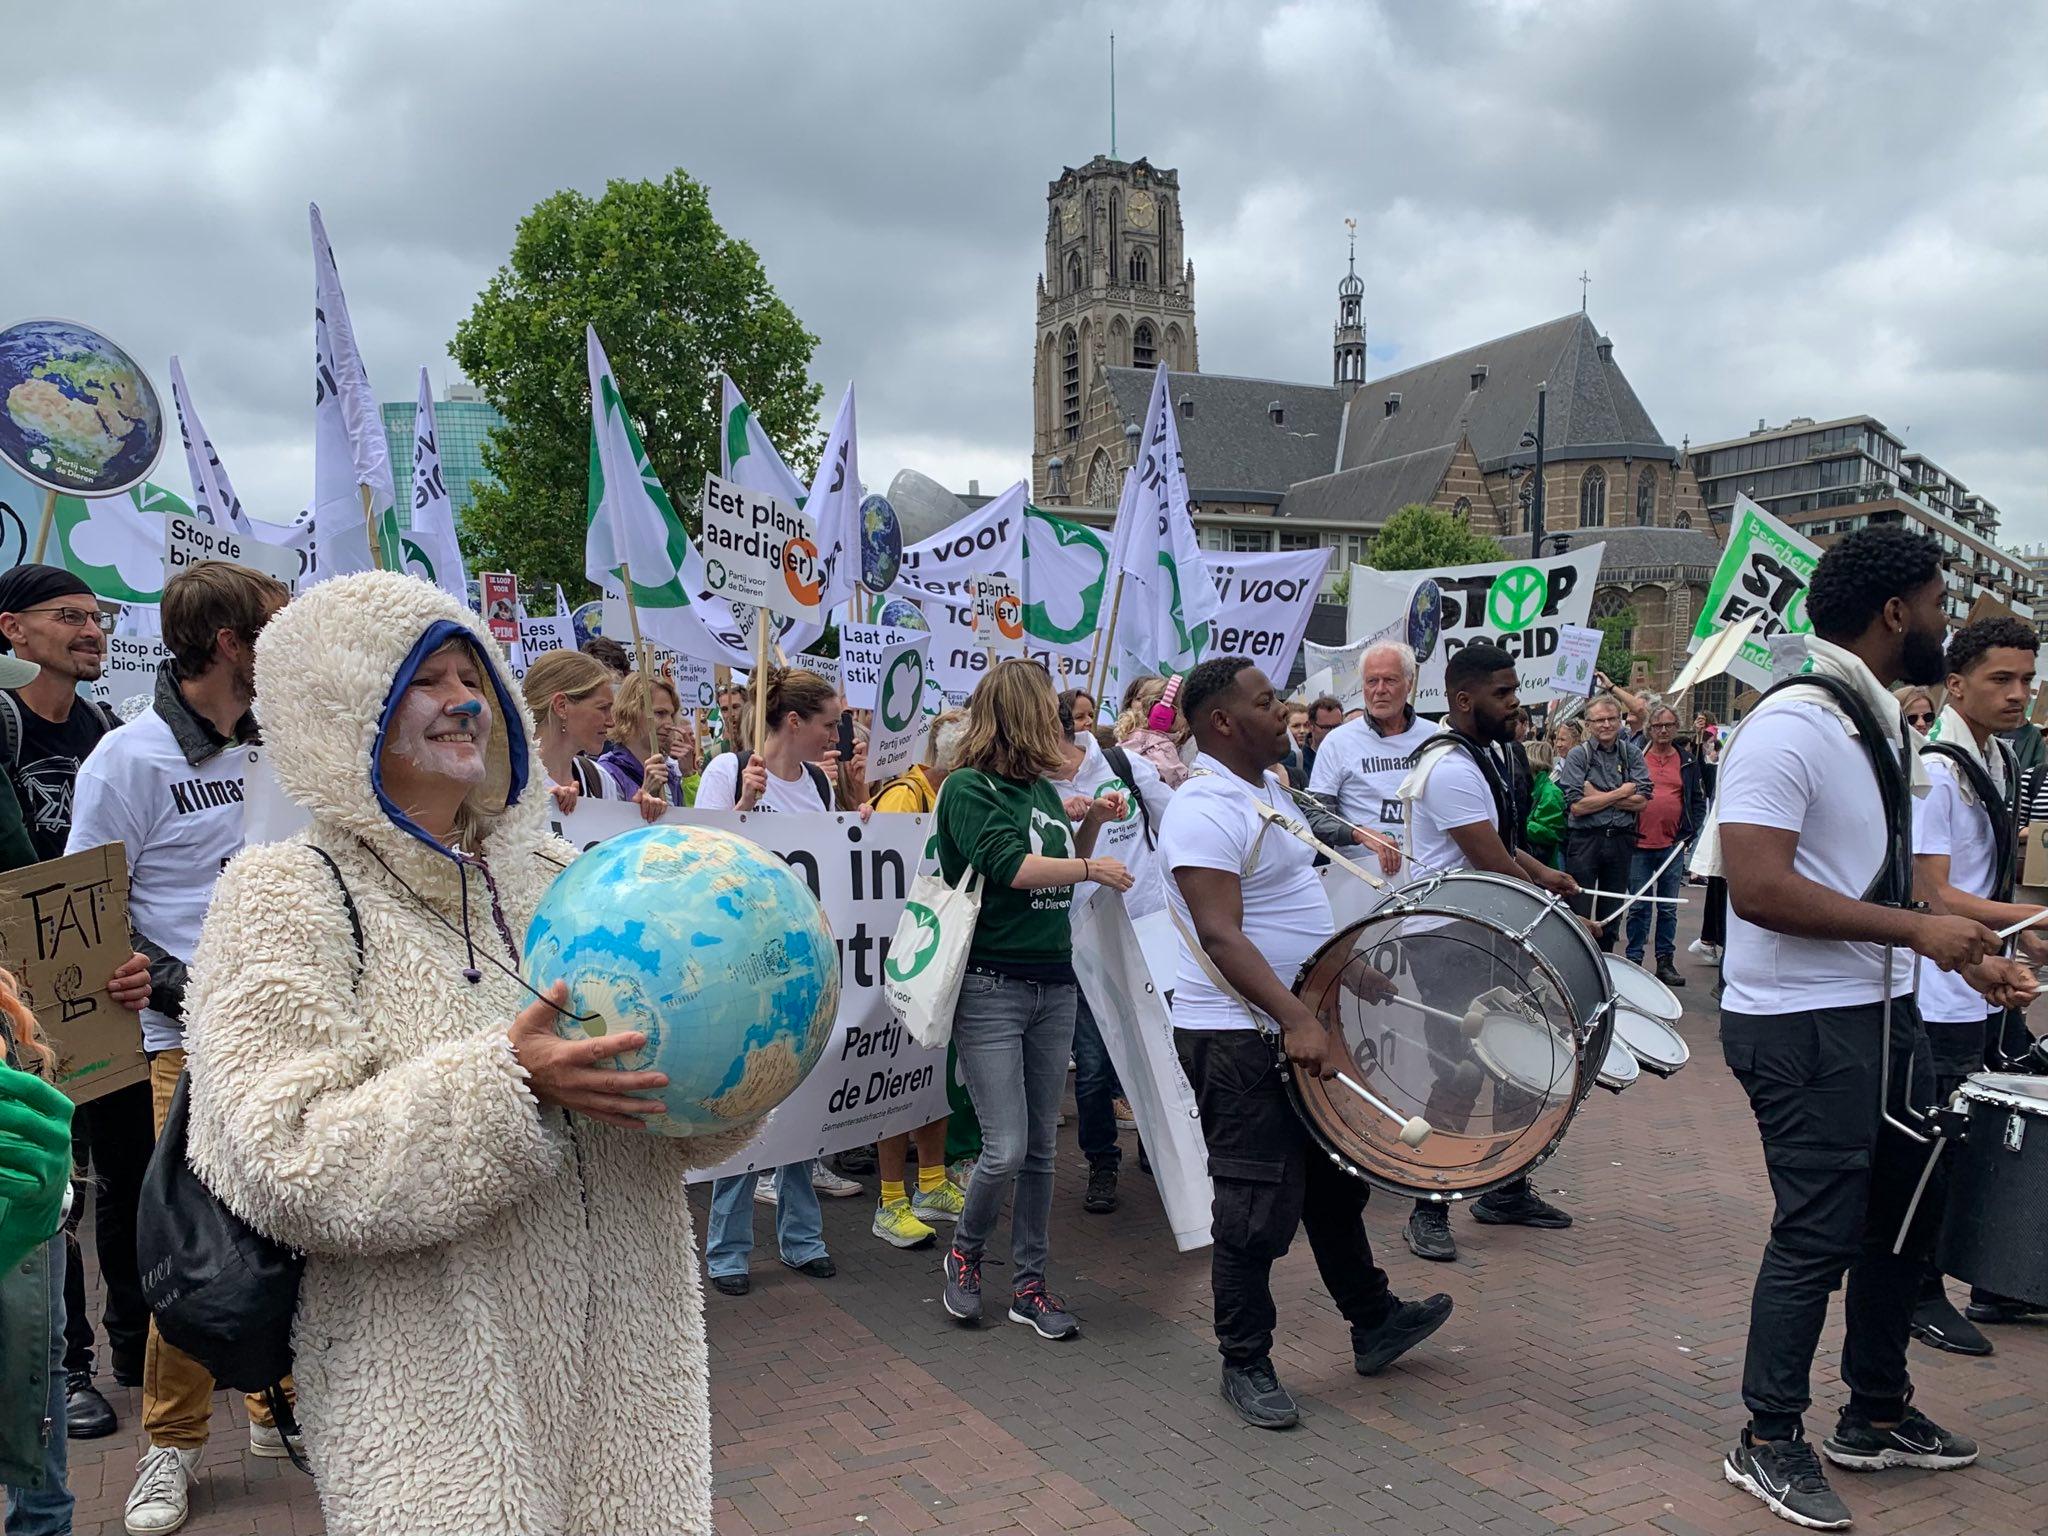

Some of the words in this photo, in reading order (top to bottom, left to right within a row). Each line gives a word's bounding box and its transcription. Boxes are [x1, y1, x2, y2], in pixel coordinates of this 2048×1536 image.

[55, 466, 66, 475] de
[67, 469, 94, 483] Dieren
[57, 457, 78, 471] Partij
[80, 465, 98, 476] voor
[708, 479, 744, 519] Eet
[752, 500, 810, 541] plant-
[171, 519, 214, 553] Stop
[218, 536, 240, 559] de
[933, 517, 1010, 562] voor
[728, 569, 747, 584] Partij
[748, 577, 766, 587] voor
[493, 585, 509, 593] VOOR
[728, 581, 737, 591] de
[738, 584, 764, 597] Dieren
[1239, 577, 1310, 604] voor
[520, 622, 555, 637] Less
[844, 625, 881, 645] Laat
[885, 631, 905, 644] de
[1209, 619, 1285, 657] ieren
[111, 639, 148, 657] Stop
[153, 643, 170, 657] de
[521, 637, 564, 652] Meat
[795, 654, 815, 667] Tijd
[817, 661, 839, 671] voor
[845, 649, 882, 664] natu
[879, 737, 899, 751] Partij
[899, 734, 912, 746] voor
[876, 754, 887, 767] de
[887, 750, 908, 764] Dieren
[1107, 824, 1126, 836] Partij
[1126, 821, 1138, 830] voor
[1109, 836, 1119, 845] de
[1119, 831, 1138, 842] Dieren
[847, 825, 906, 901] in
[1031, 898, 1044, 910] de
[1045, 899, 1071, 910] Dieren
[22, 878, 113, 960] FAT
[894, 990, 912, 1004] voor
[841, 1018, 902, 1062] Partij
[828, 1078, 861, 1114] de
[864, 1064, 933, 1105] Dieren
